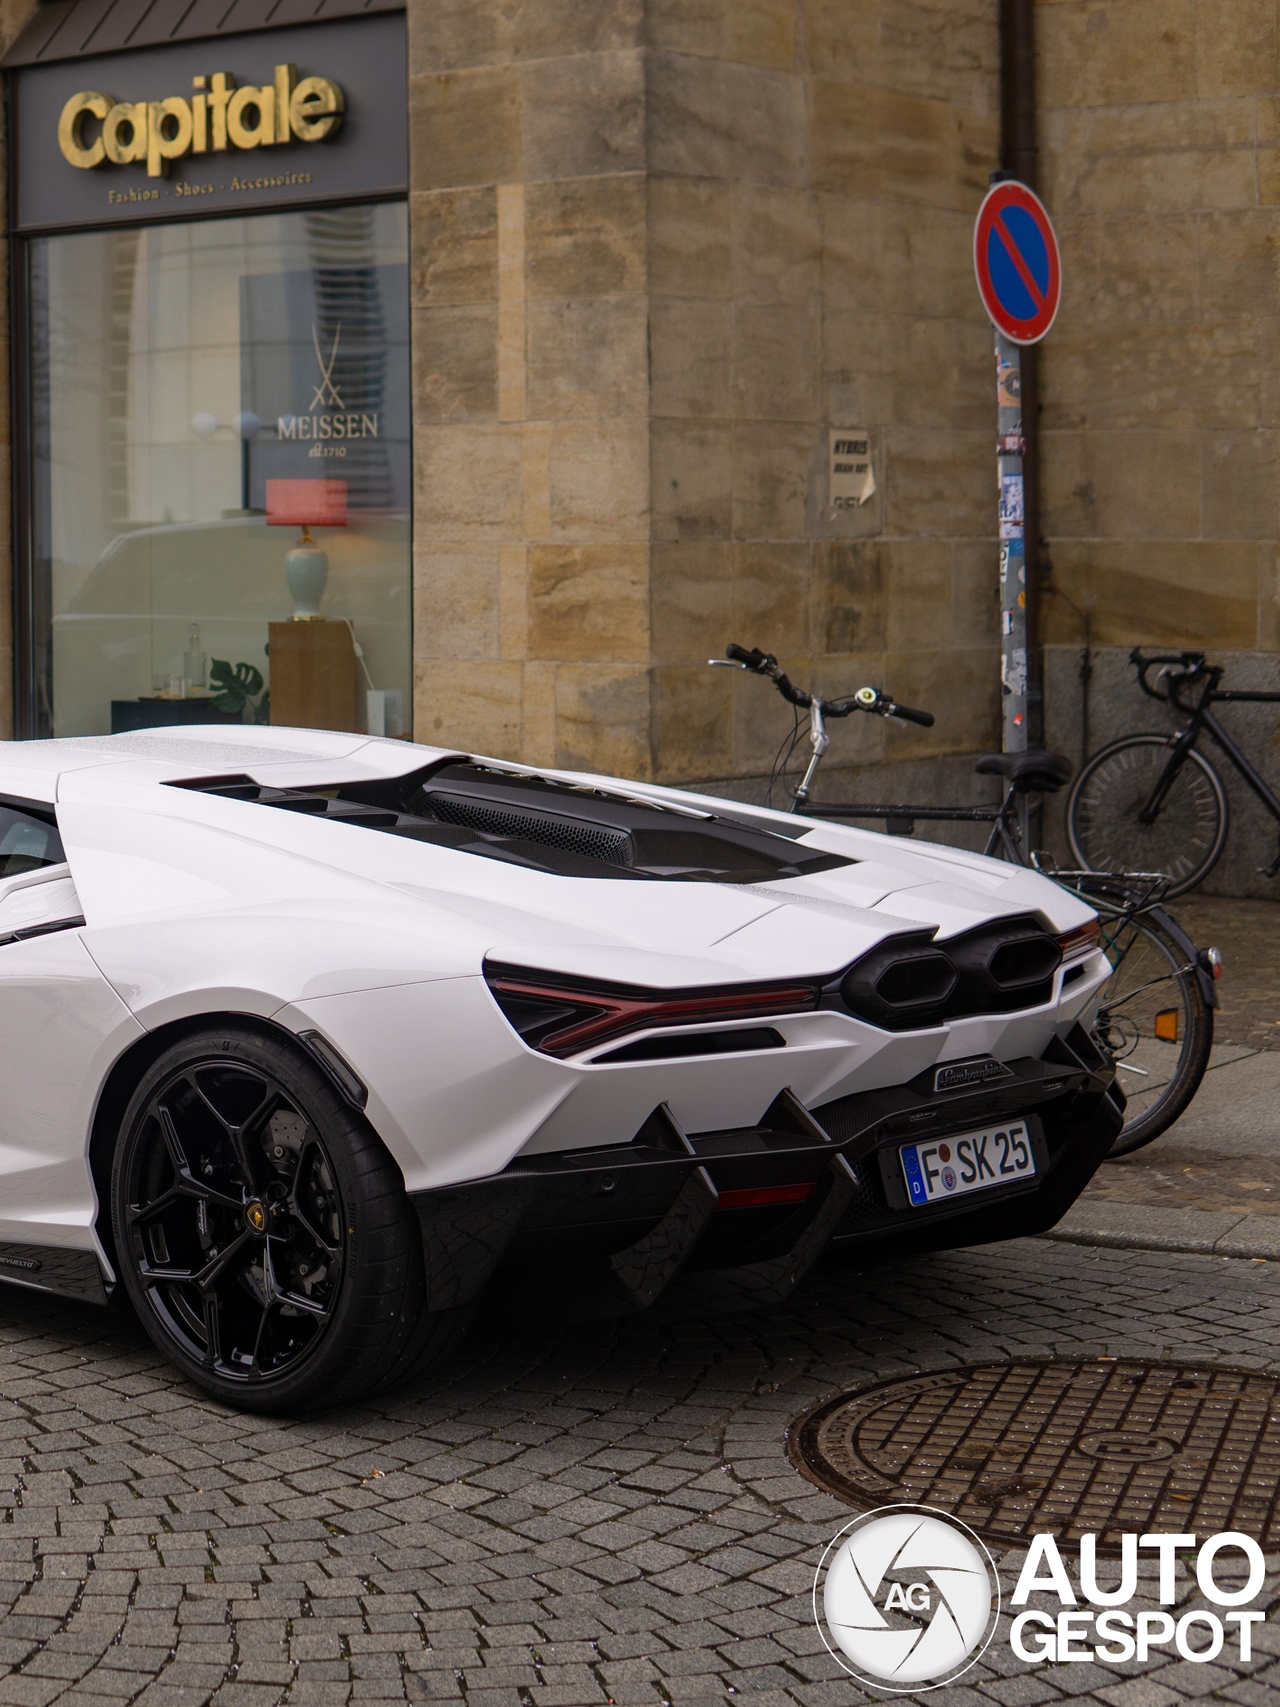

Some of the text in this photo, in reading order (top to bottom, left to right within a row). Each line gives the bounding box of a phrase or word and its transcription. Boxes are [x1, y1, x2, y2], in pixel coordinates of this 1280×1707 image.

[58, 63, 342, 178] Capitale
[108, 171, 312, 204] Fashion Shoes Accessoires
[277, 413, 378, 440] MEISSEN
[921, 1127, 1029, 1194] F SK 25
[912, 1181, 920, 1195] D
